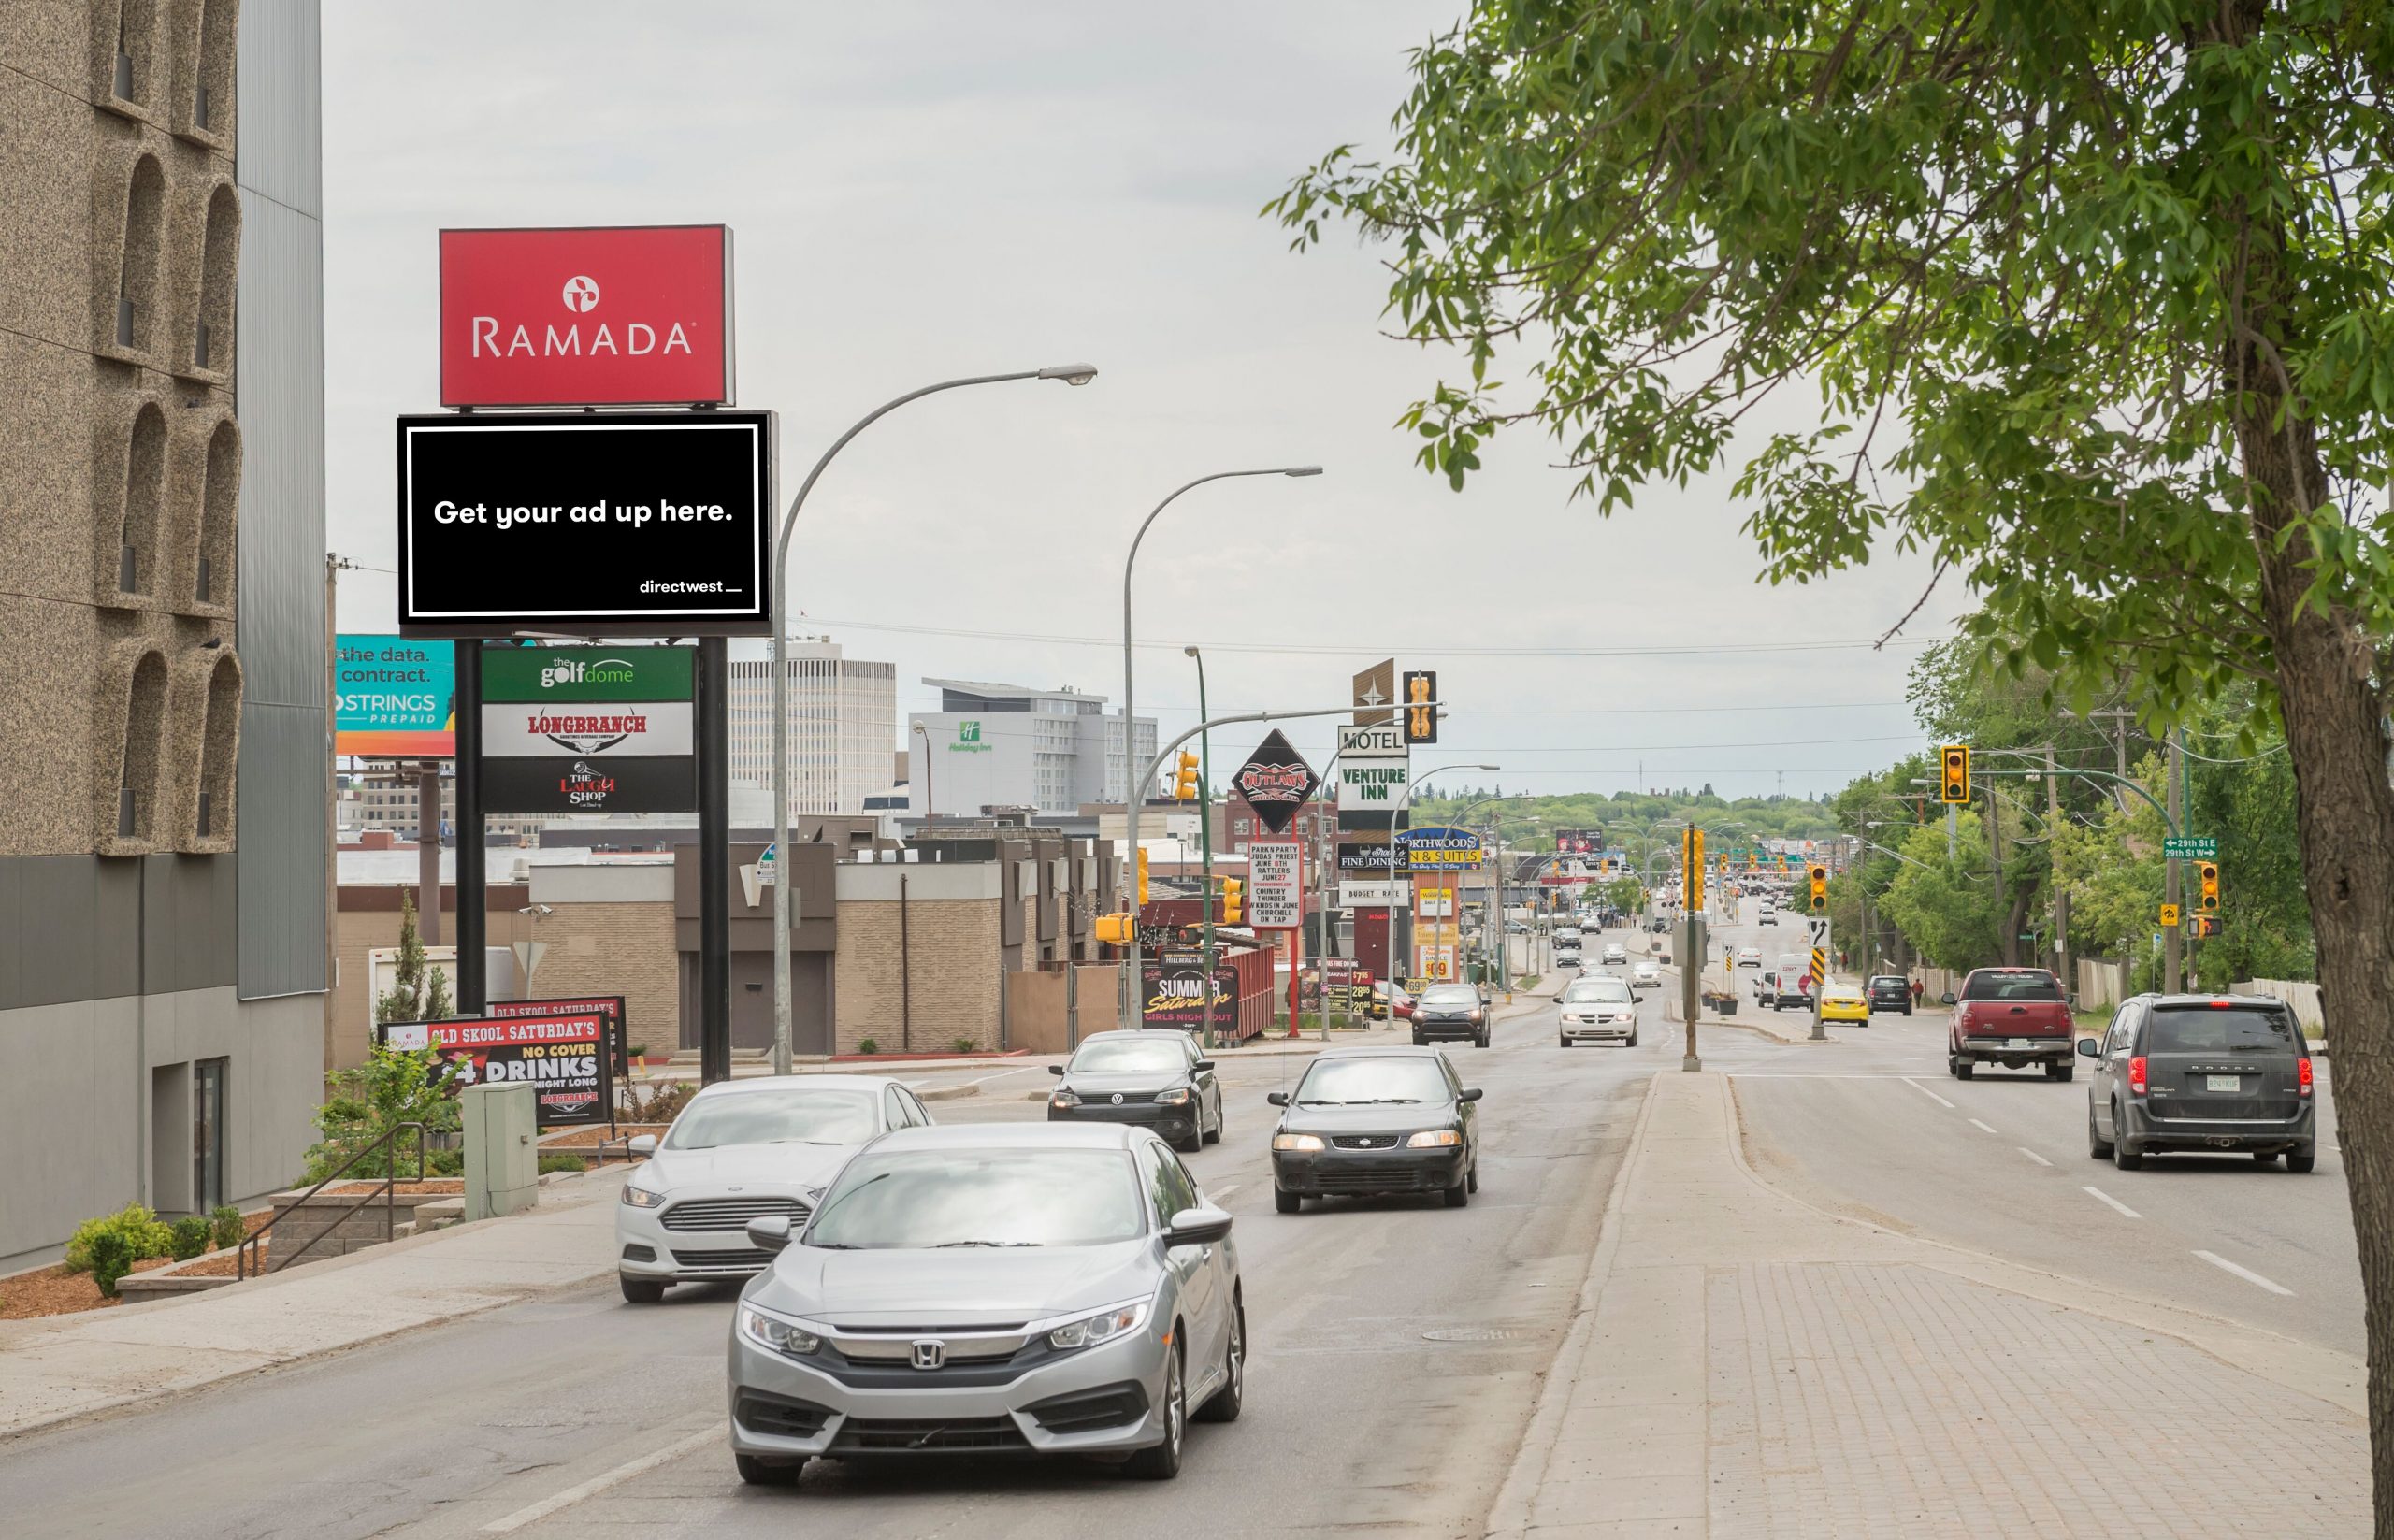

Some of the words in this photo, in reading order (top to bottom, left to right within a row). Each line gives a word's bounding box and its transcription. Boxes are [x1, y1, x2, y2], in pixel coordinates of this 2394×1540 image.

[472, 316, 692, 358] RAMADA
[434, 501, 487, 524] Get
[496, 504, 562, 530] your
[570, 500, 607, 523] ad
[615, 504, 653, 528] up
[660, 499, 732, 522] here.
[640, 580, 724, 594] directwest
[342, 647, 375, 662] the
[381, 646, 430, 663] data.
[554, 657, 570, 667] the
[341, 668, 431, 683] contract.
[370, 714, 436, 724] PREPAID
[528, 715, 647, 733] LONGBRANCH
[1343, 732, 1403, 750] MOTEL
[570, 774, 591, 783] THE
[1242, 770, 1307, 791] OUTLAWS
[1342, 768, 1406, 784] VENTURE
[560, 778, 614, 792] LAUGH
[1361, 784, 1388, 800] INN
[570, 791, 606, 804] SHOP
[2177, 839, 2198, 847] 29th
[2199, 839, 2208, 847] St
[2210, 839, 2215, 847] E
[2165, 849, 2184, 857] 29th
[2185, 849, 2195, 857] St
[2196, 849, 2204, 857] W
[1342, 857, 1364, 866] FINE
[497, 1008, 515, 1017] OLD
[519, 1006, 547, 1016] SKOOL
[553, 1003, 614, 1015] SATURDAY'S
[1145, 1013, 1175, 1021] GIRLS
[1176, 1013, 1206, 1021] NIGH
[462, 1026, 505, 1043] SKOOL
[509, 1022, 595, 1040] SATURDAY'S
[522, 1046, 545, 1058] NO
[549, 1043, 596, 1057] COVER
[486, 1056, 598, 1082] DRINKS
[534, 1079, 566, 1089] NIGHT
[569, 1077, 598, 1087] LONG
[541, 1091, 598, 1104] LONGBRANCH
